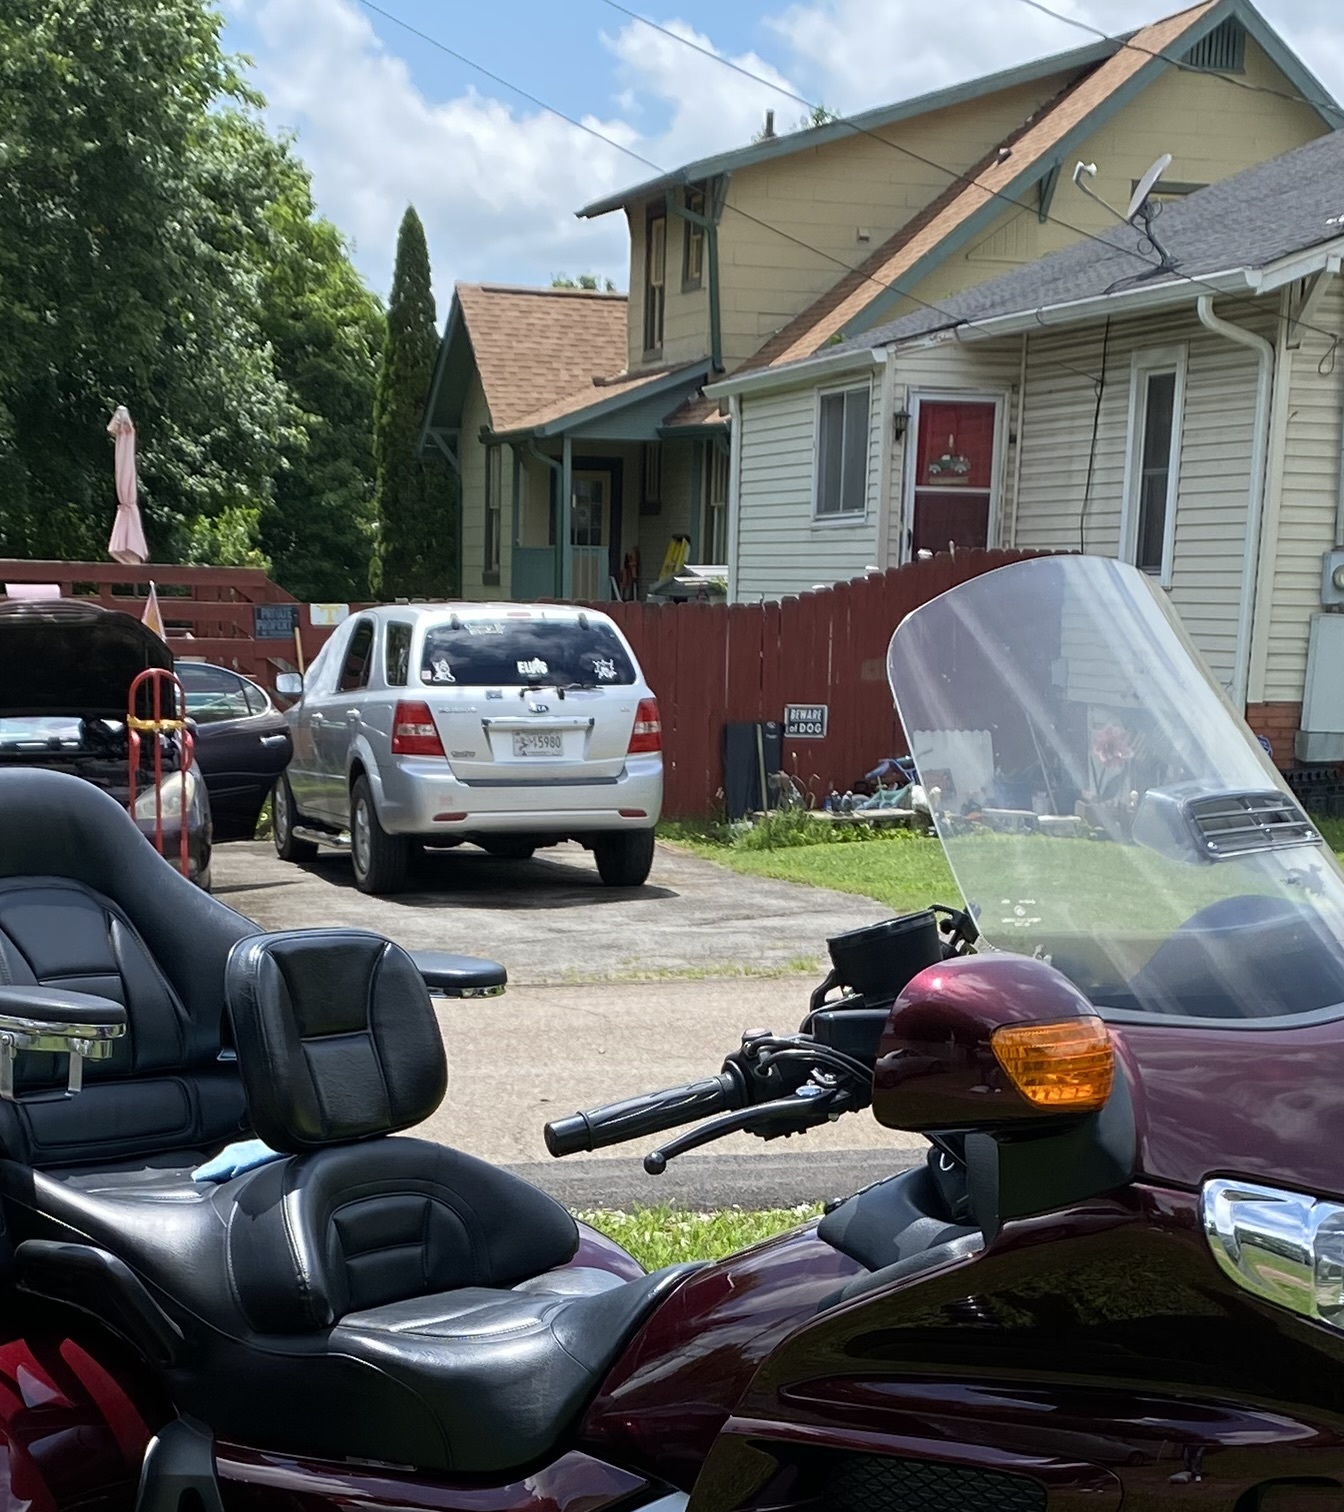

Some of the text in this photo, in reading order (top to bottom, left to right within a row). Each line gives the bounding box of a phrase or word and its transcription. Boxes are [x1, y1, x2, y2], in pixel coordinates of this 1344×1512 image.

[790, 709, 822, 721] BEWARE
[789, 722, 822, 733] of DOG
